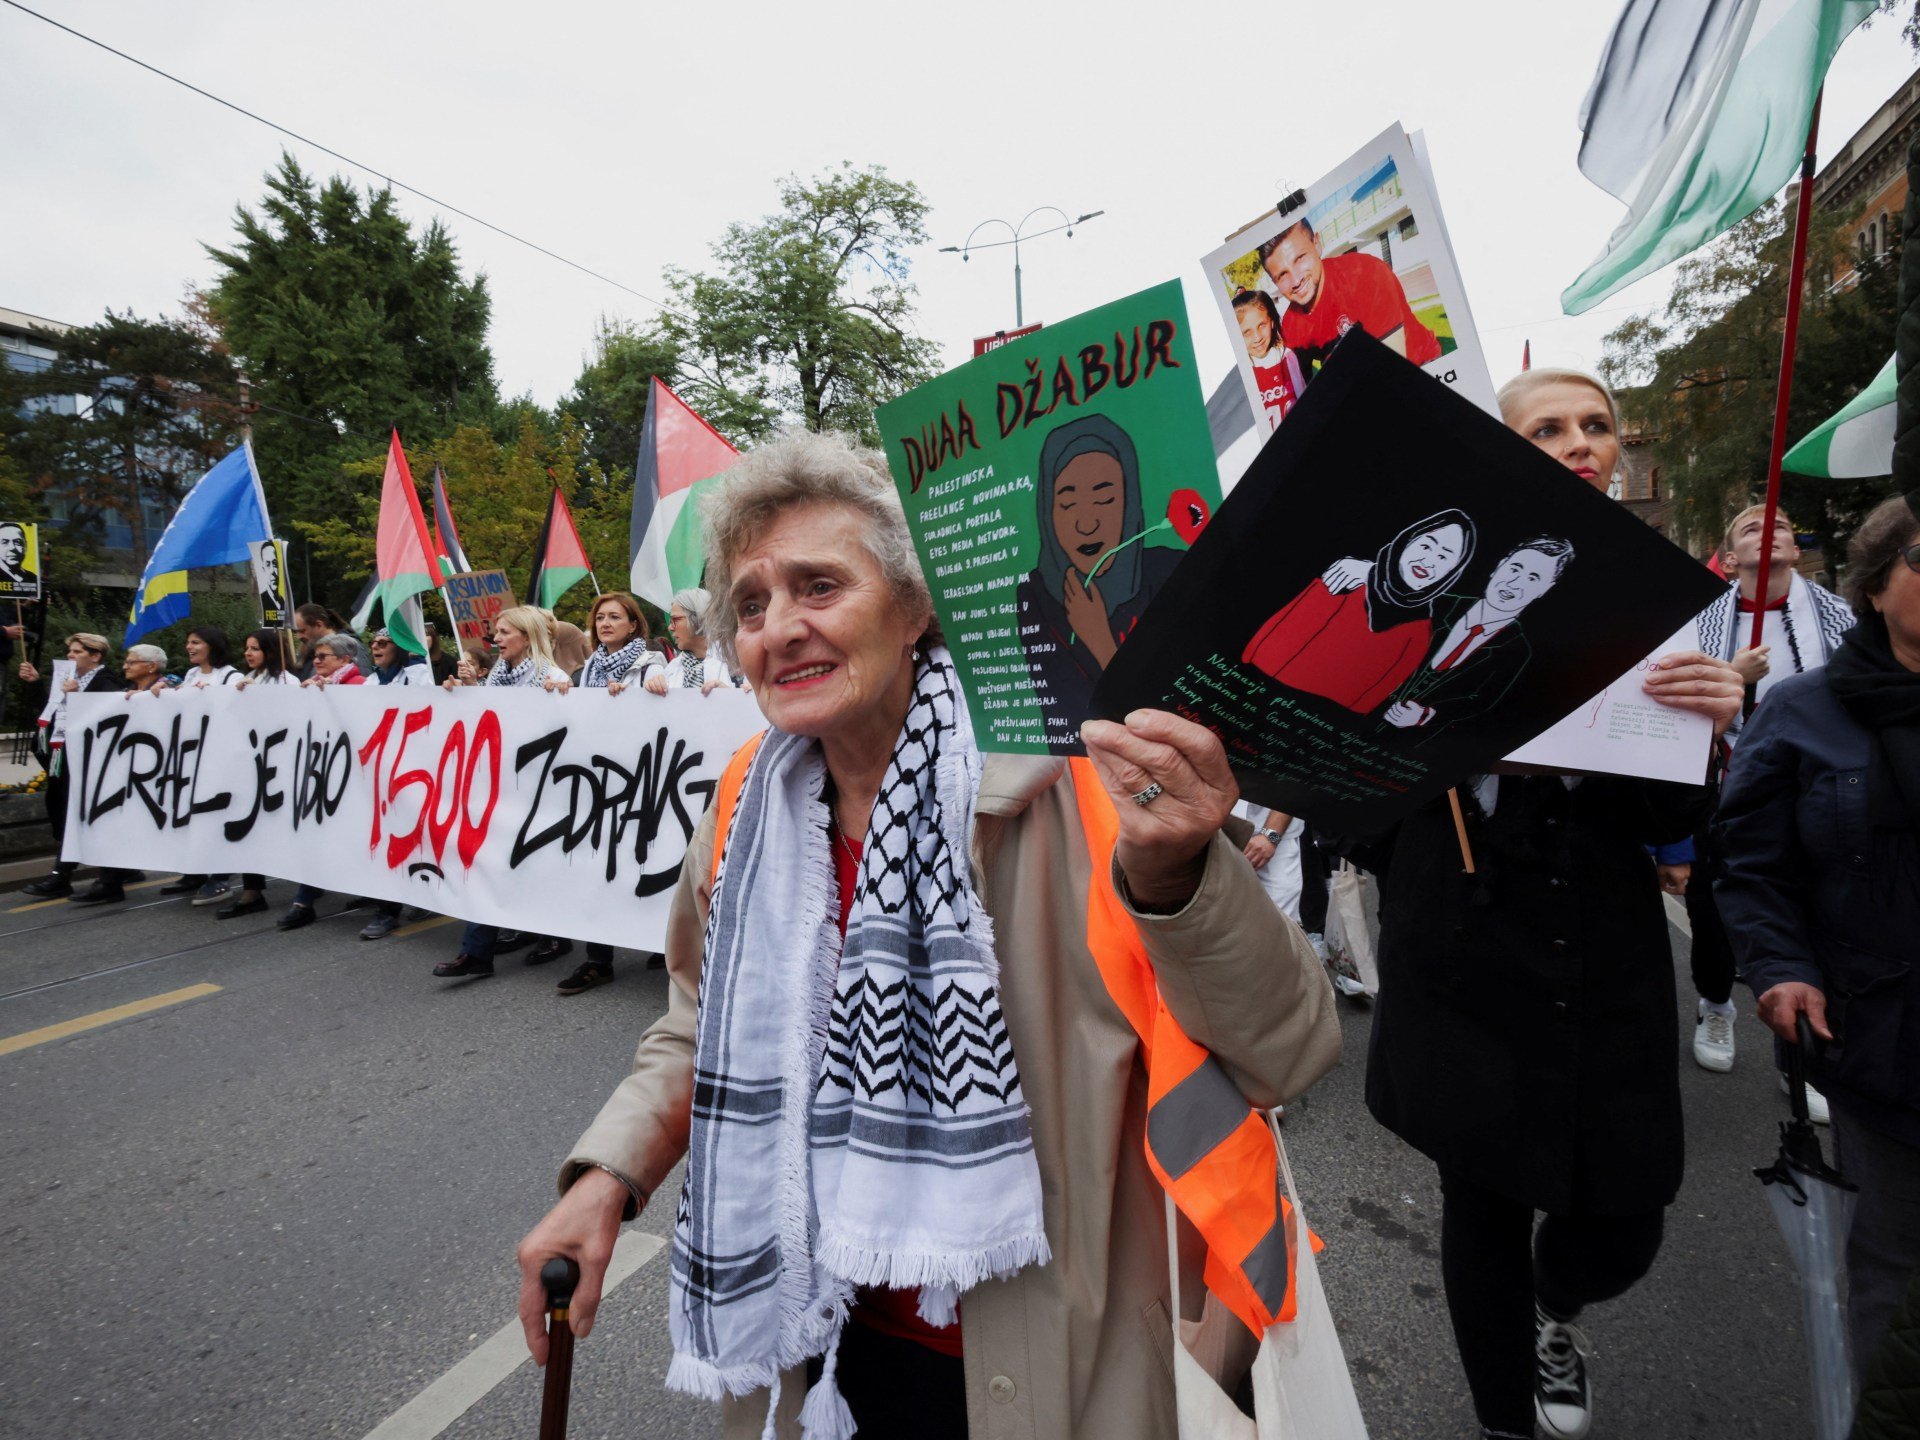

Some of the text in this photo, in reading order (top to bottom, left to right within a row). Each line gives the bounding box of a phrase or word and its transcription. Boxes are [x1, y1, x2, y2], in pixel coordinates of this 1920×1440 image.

[900, 320, 1181, 494] DUAA DŽABUR
[928, 464, 994, 499] PALESTINSKA
[920, 475, 1034, 523] FREELANCE NOVINARKA,
[924, 508, 1002, 542] SURADNICA PORTALA
[929, 545, 948, 559] EYES
[952, 538, 974, 553] MEDIA
[936, 562, 963, 578] UBIJENA
[1012, 546, 1019, 557] U
[943, 572, 1030, 600] IZRAELSKOM NAPADU NA
[952, 610, 967, 622] HAN
[970, 608, 988, 619] JUNIS
[991, 606, 996, 615] U
[1023, 601, 1029, 612] U
[961, 624, 1040, 643] NAPADU UBIJENI I NJEN
[967, 650, 991, 661] SUPRUG
[1022, 646, 1027, 655] U
[1030, 643, 1056, 654] SVOJOJ
[972, 663, 1042, 676] POSLJEDNJOJ OBJAVI NA
[1207, 653, 1267, 695] Najmanje
[1269, 697, 1296, 709] pet
[977, 677, 1048, 695] DRUŠTVENIM MREŽAMA
[1173, 676, 1203, 705] kamp
[1186, 664, 1239, 701] napadima
[1243, 702, 1257, 712] na
[1266, 711, 1290, 729] Gazu
[984, 697, 1009, 710] DŽABUR
[1013, 699, 1020, 707] JE
[1047, 717, 1068, 726] SVAKI
[997, 733, 1010, 742] DAN
[1014, 733, 1021, 743] JE
[80, 713, 232, 830] IZRAEL
[358, 705, 502, 871] 1.500
